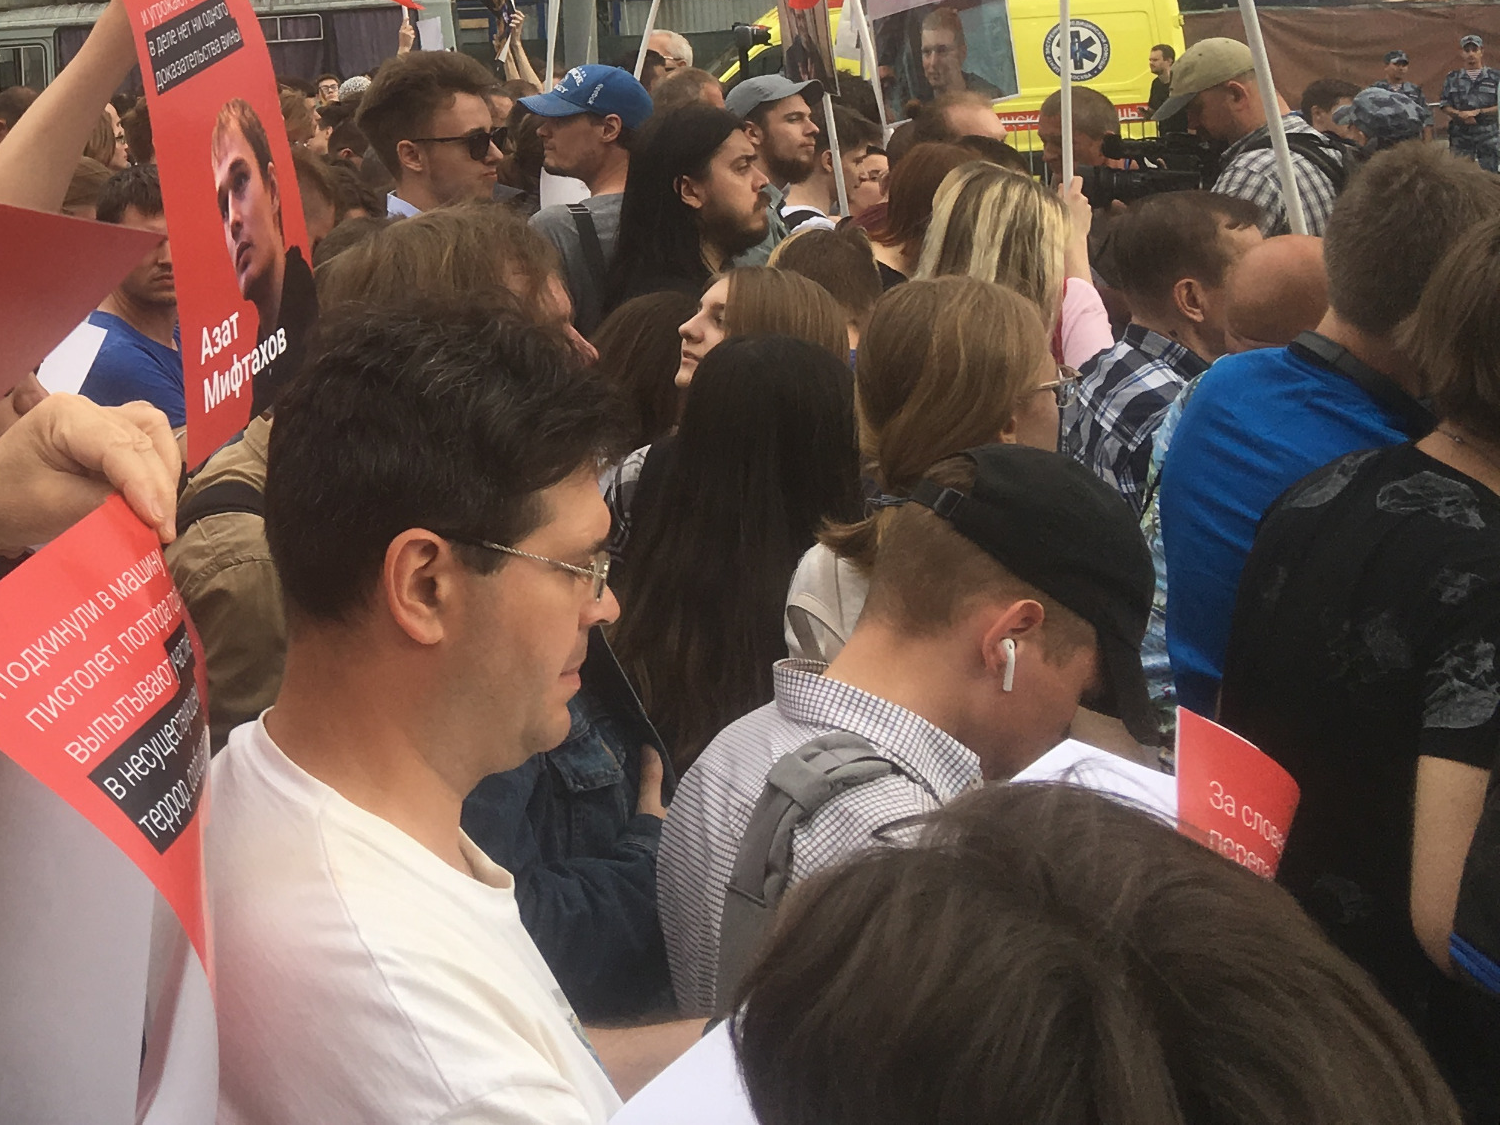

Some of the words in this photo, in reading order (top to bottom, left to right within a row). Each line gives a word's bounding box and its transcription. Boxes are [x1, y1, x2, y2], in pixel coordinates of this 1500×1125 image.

[139, 10, 147, 26] и
[148, 40, 157, 57] в
[156, 30, 179, 58] деле
[177, 21, 191, 42] нет
[190, 17, 203, 34] ни
[202, 2, 229, 29] одного
[155, 38, 222, 92] доказательства
[222, 27, 242, 54] вины
[201, 311, 240, 366] Азат
[203, 327, 288, 414] Мифтахов
[96, 590, 117, 611] в
[108, 548, 167, 602] машину
[25, 644, 130, 732] пистолет,
[117, 599, 173, 656] полтора
[64, 658, 176, 765] выпытывают
[103, 776, 127, 801] в
[1209, 780, 1236, 819] За
